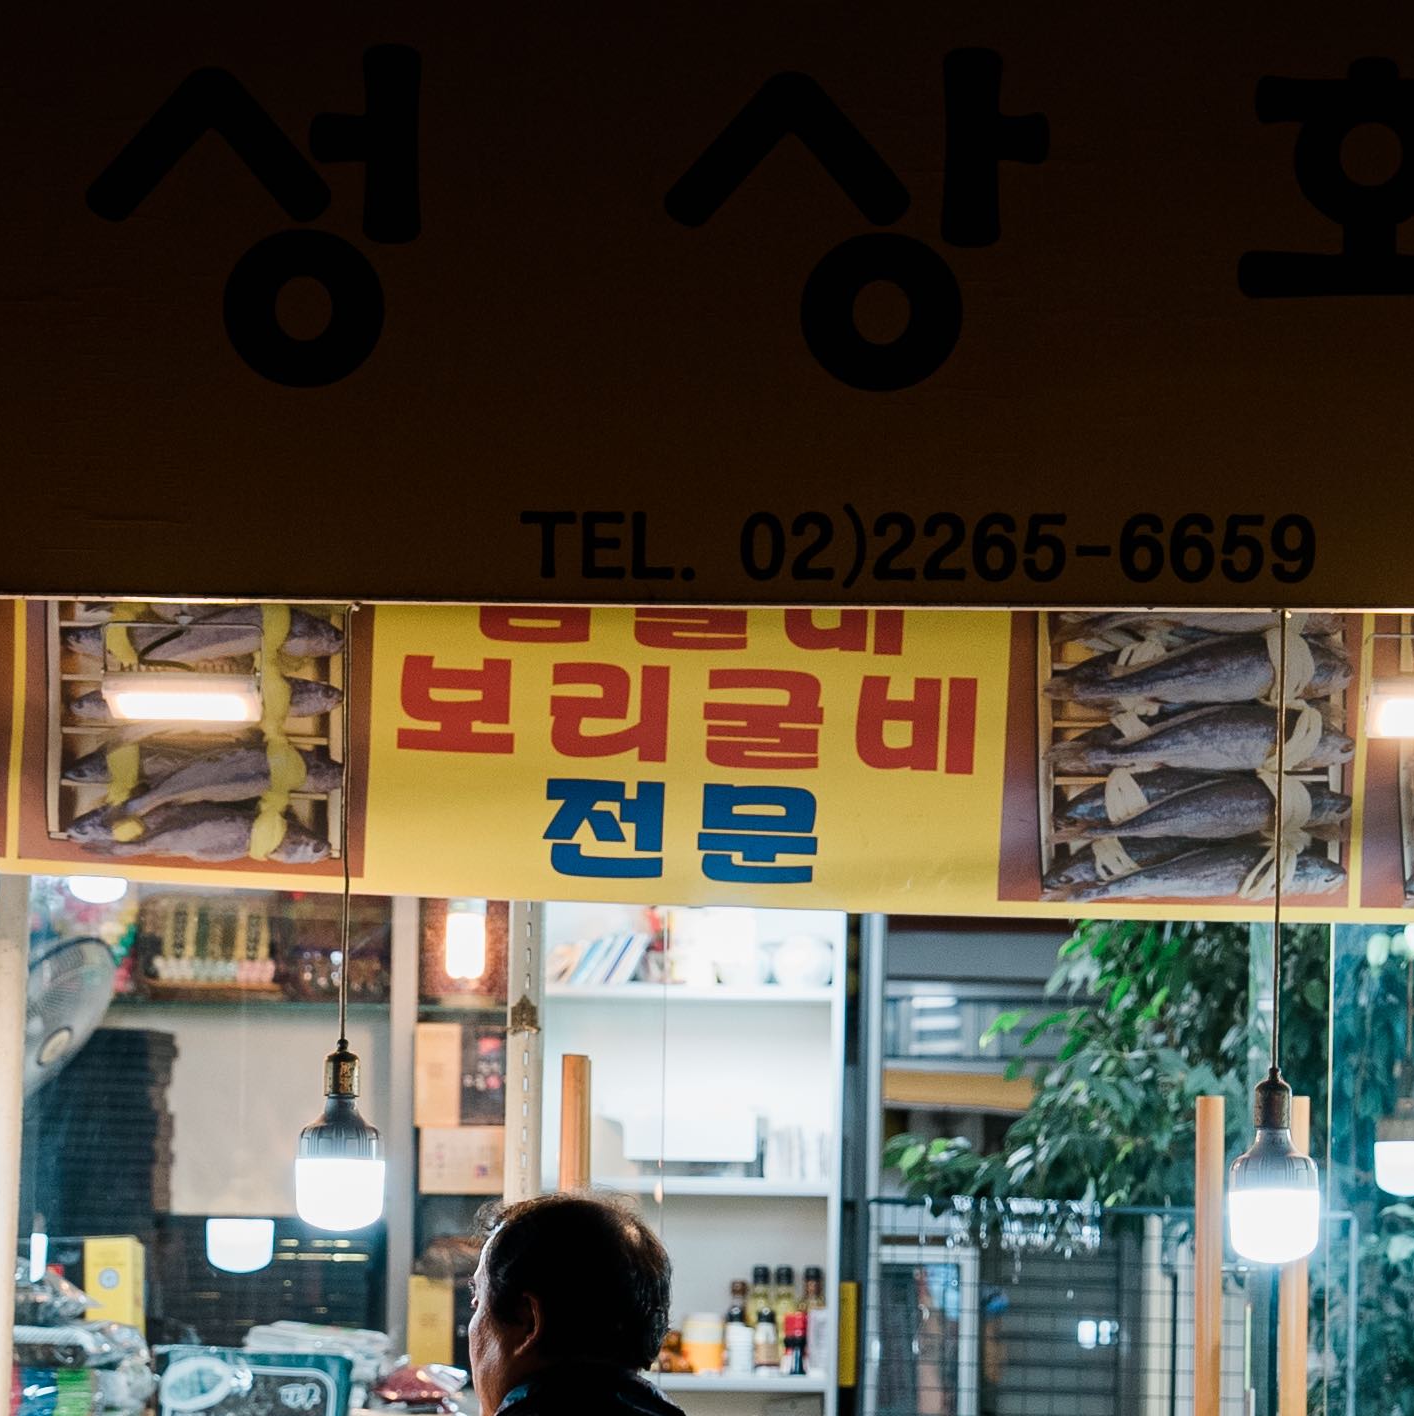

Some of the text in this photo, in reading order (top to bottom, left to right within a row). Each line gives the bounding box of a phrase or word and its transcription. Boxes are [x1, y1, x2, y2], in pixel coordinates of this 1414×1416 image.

[520, 503, 1316, 588] TEL. 02)2265-6659
[396, 654, 978, 775] 보리굴비
[543, 778, 818, 883] 전문
